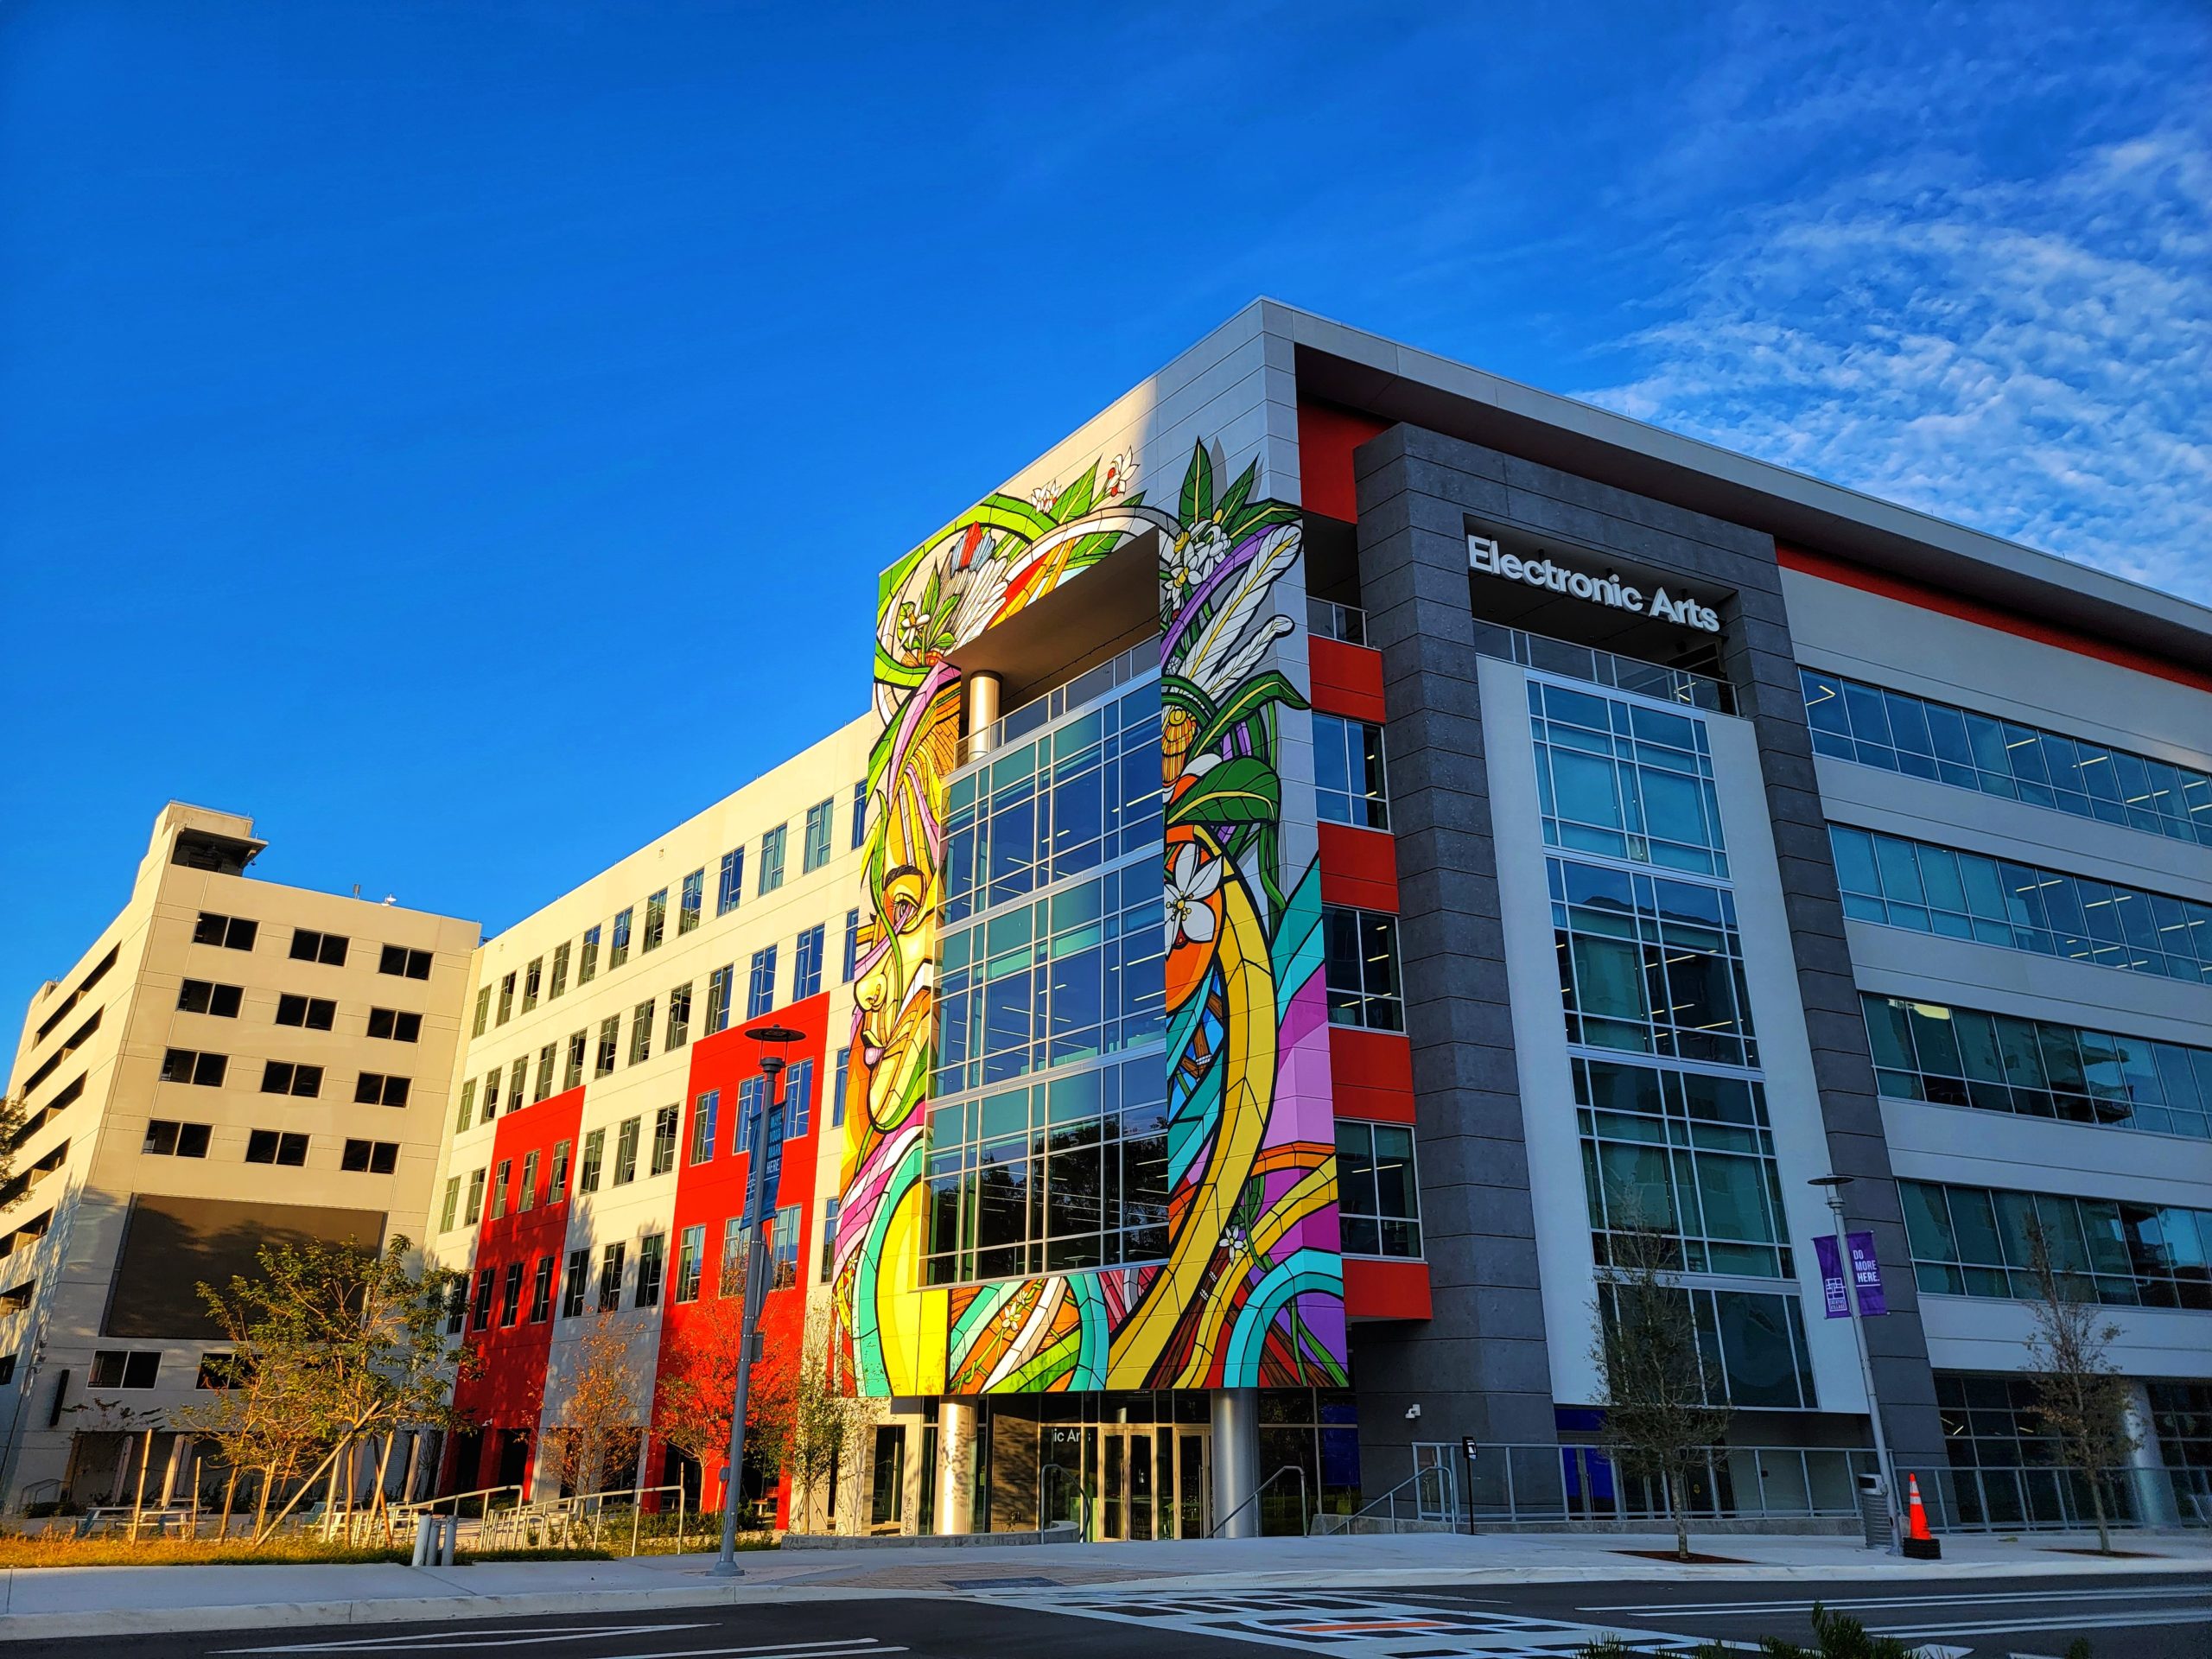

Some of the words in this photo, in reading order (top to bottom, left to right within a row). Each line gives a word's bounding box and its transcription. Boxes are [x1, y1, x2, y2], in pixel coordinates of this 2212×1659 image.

[1467, 534, 1643, 612] Electronic
[1649, 587, 1720, 632] Arts
[1853, 1249, 1864, 1260] DO
[1855, 1260, 1877, 1271] MORE
[1857, 1272, 1880, 1283] HERE.
[1066, 1428, 1091, 1442] Ar
